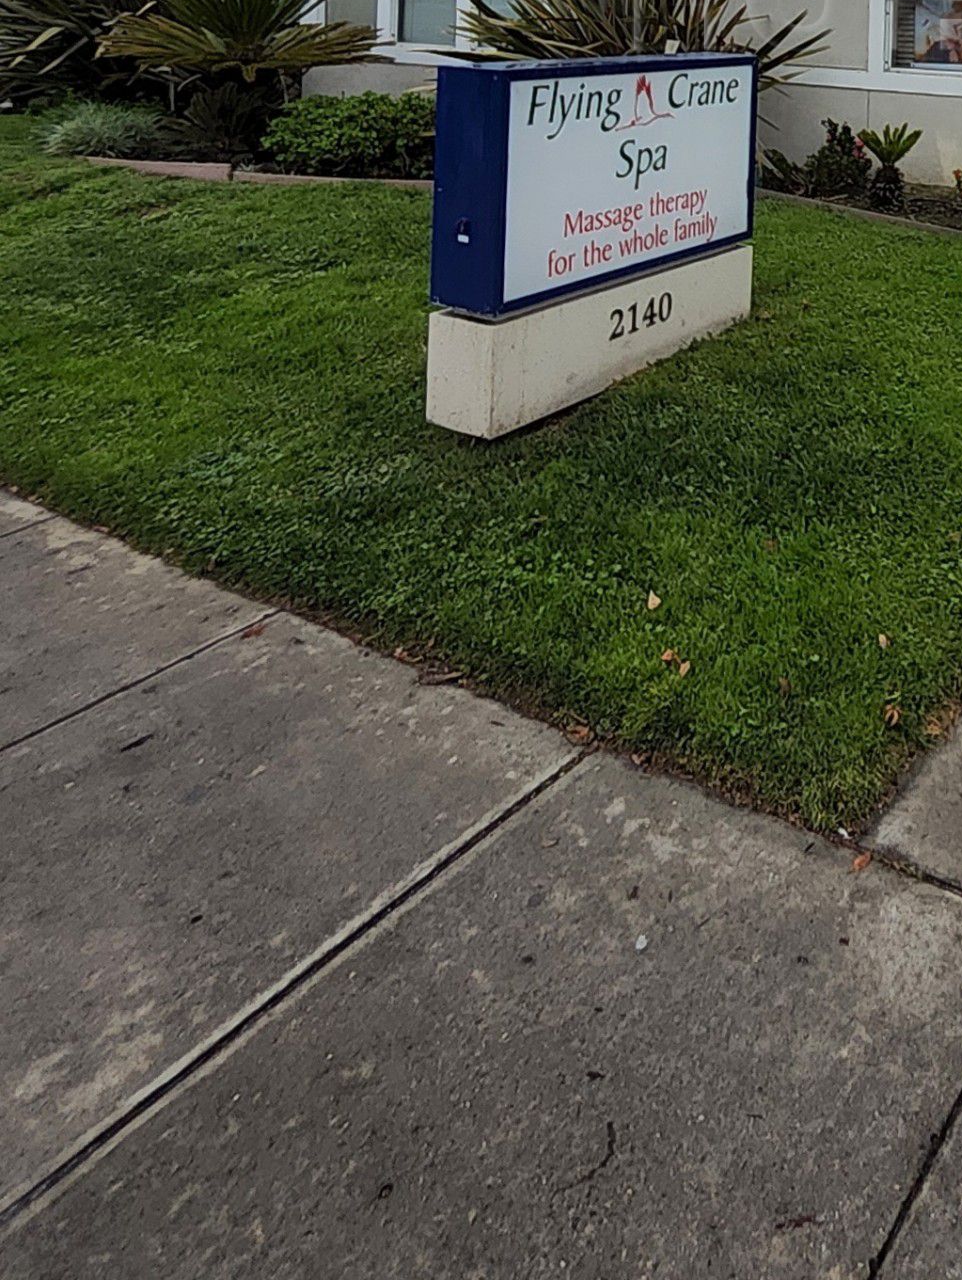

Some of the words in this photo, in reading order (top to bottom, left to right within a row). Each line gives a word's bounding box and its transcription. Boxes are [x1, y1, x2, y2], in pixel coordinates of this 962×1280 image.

[527, 79, 623, 140] Flying
[667, 73, 740, 109] Crane
[615, 139, 668, 190] Spa
[563, 203, 643, 239] Massage
[649, 188, 709, 218] therapy
[547, 248, 574, 278] for
[583, 240, 613, 267] the
[618, 224, 669, 257] whole
[674, 212, 719, 243] family
[608, 291, 674, 342] 2140
